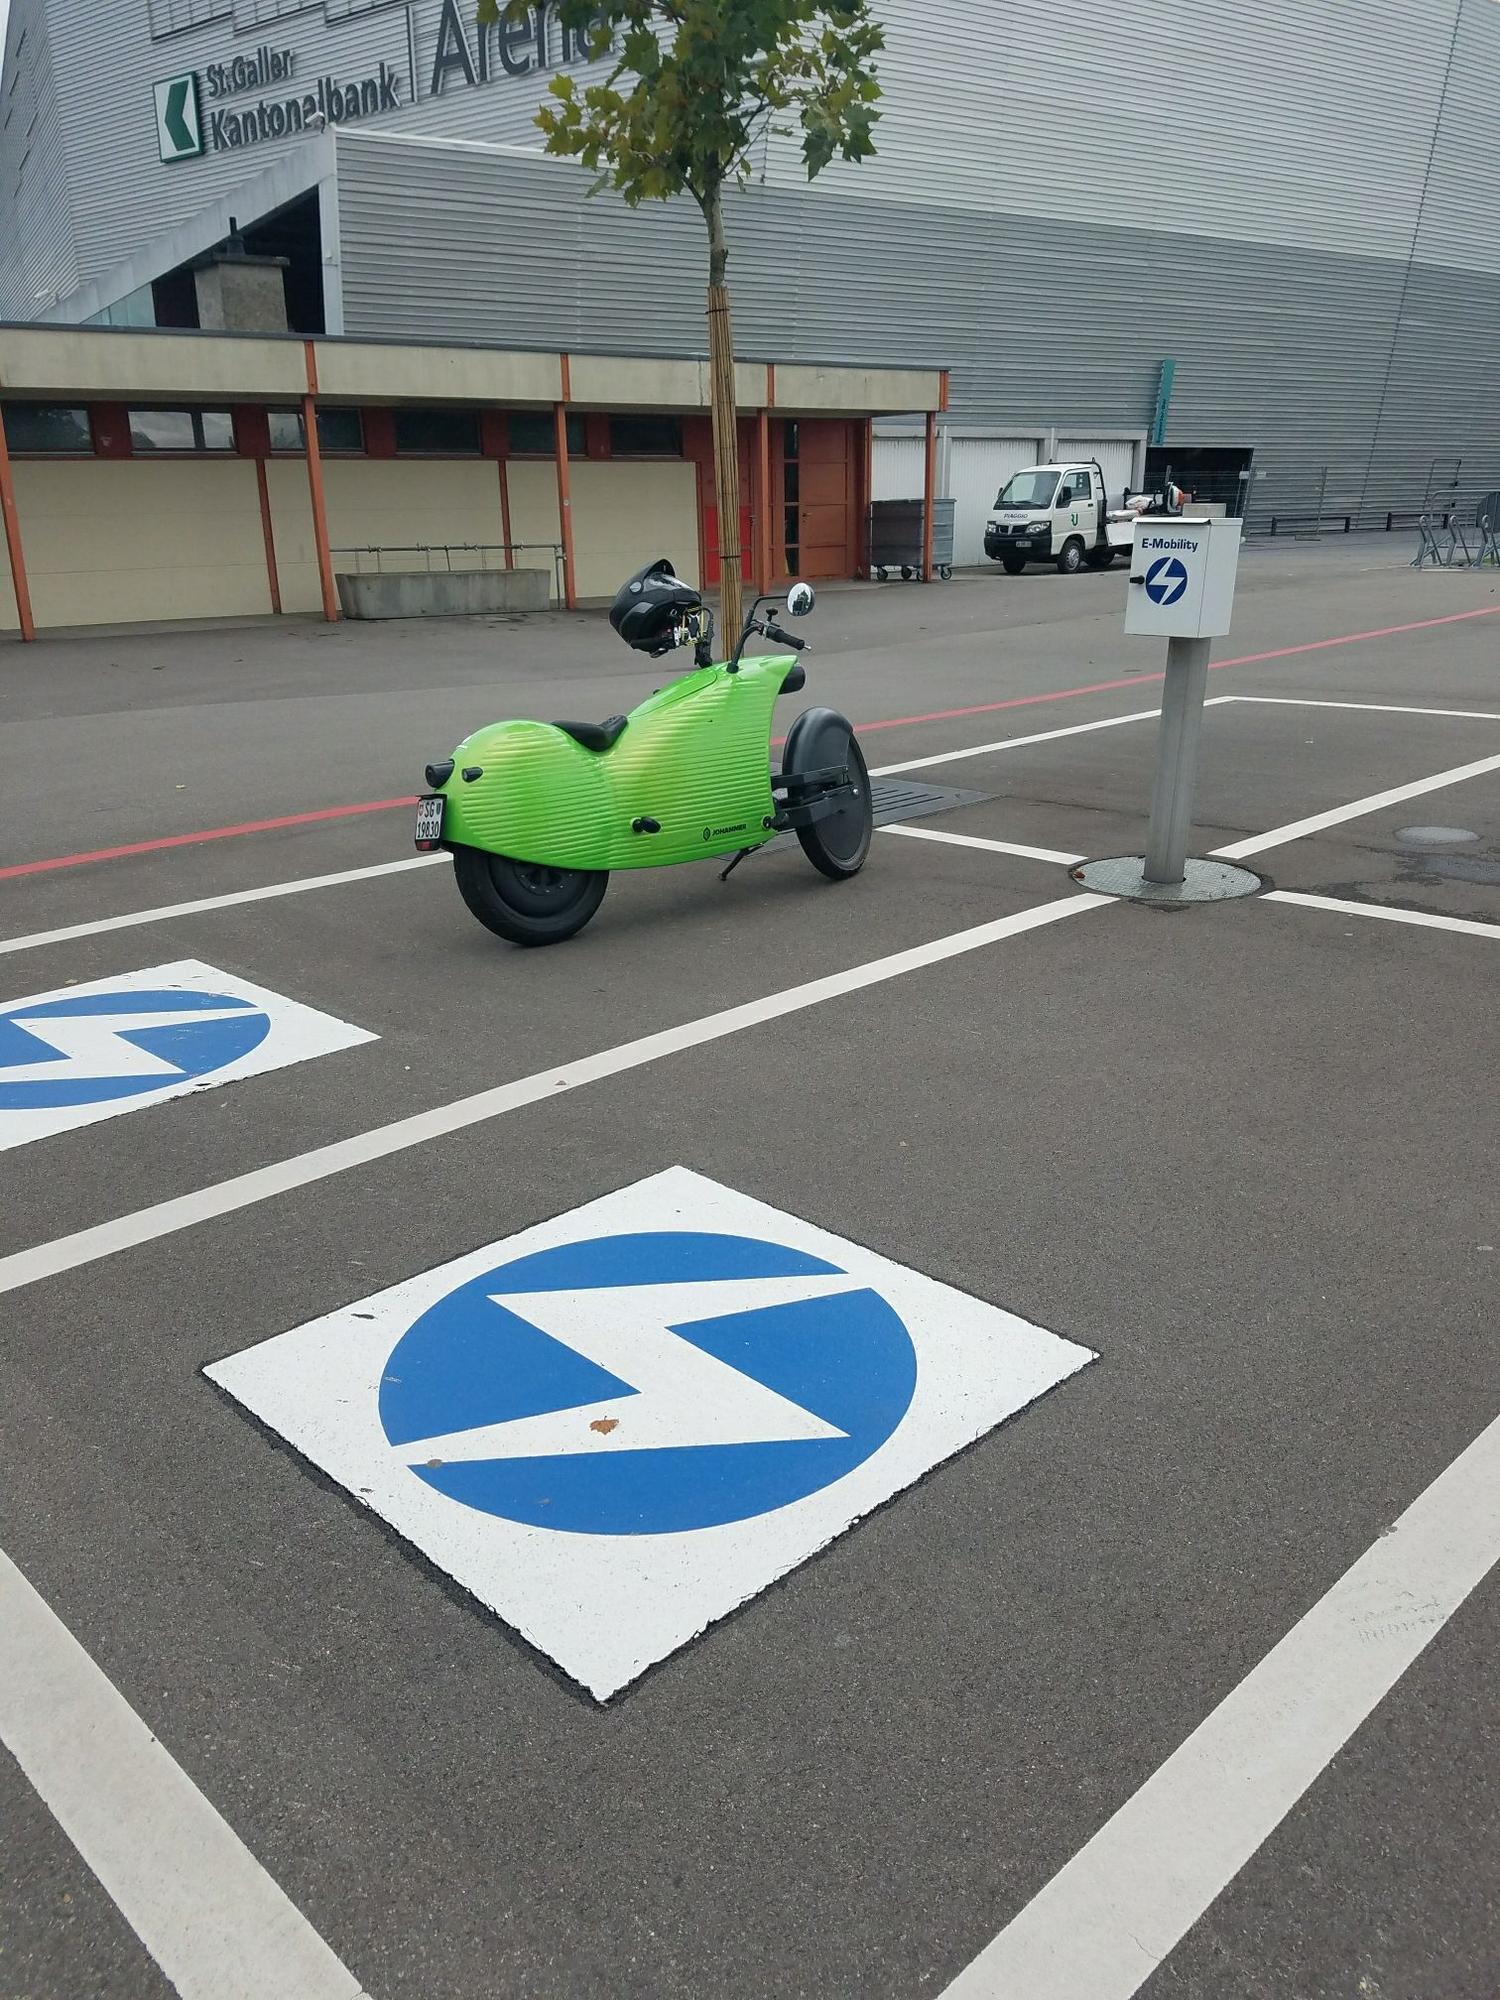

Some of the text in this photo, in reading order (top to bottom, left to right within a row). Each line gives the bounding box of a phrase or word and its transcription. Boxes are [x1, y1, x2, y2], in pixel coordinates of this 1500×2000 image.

[211, 62, 400, 151] Kantonalbank
[1141, 537, 1199, 553] E-Mobility
[424, 801, 436, 818] SG
[416, 820, 440, 838] 19830
